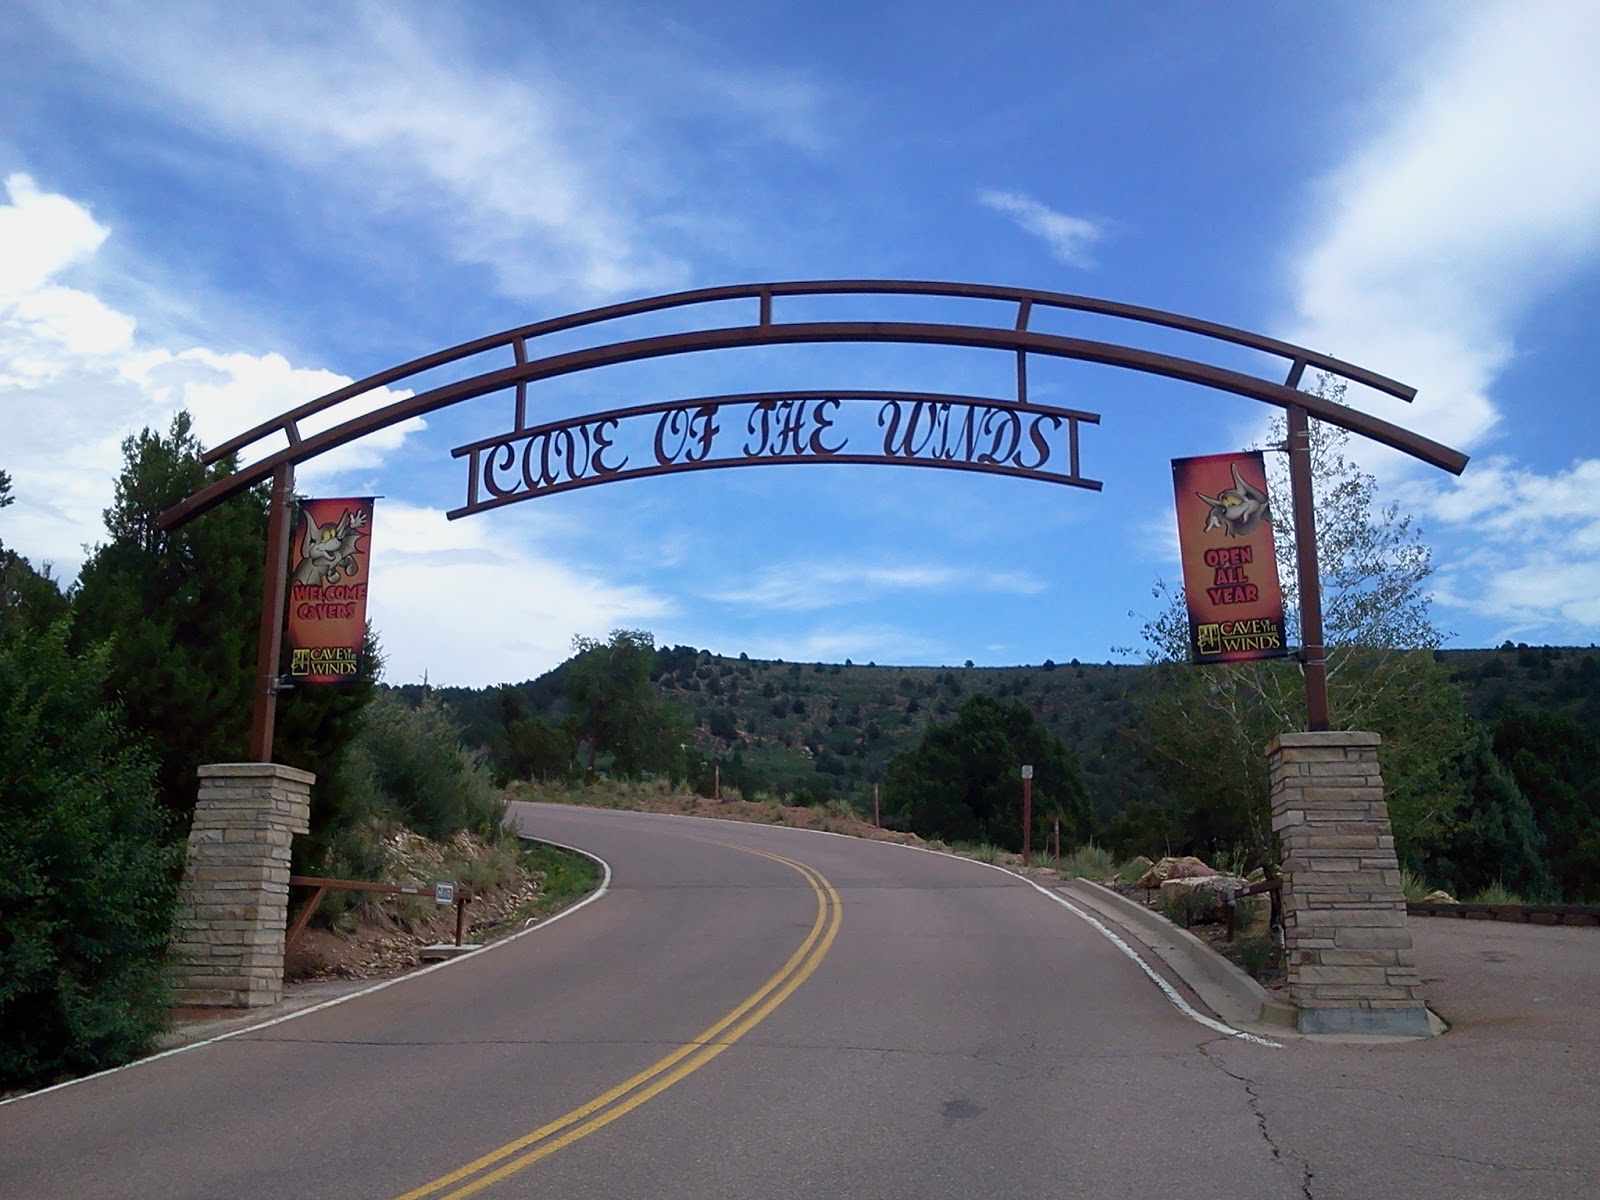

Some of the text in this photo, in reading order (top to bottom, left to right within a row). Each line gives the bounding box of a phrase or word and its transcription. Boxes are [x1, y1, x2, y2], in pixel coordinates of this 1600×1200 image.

[484, 399, 1062, 498] CAVE OF THE WINDS
[1204, 545, 1253, 567] OPEN
[1214, 566, 1249, 586] ALL
[293, 583, 367, 602] WELCOME
[1206, 583, 1259, 606] YEAR
[1220, 620, 1260, 635] CAVE
[1223, 635, 1280, 651] WINDS
[310, 647, 343, 660] CAVE
[311, 663, 357, 674] WINDS
